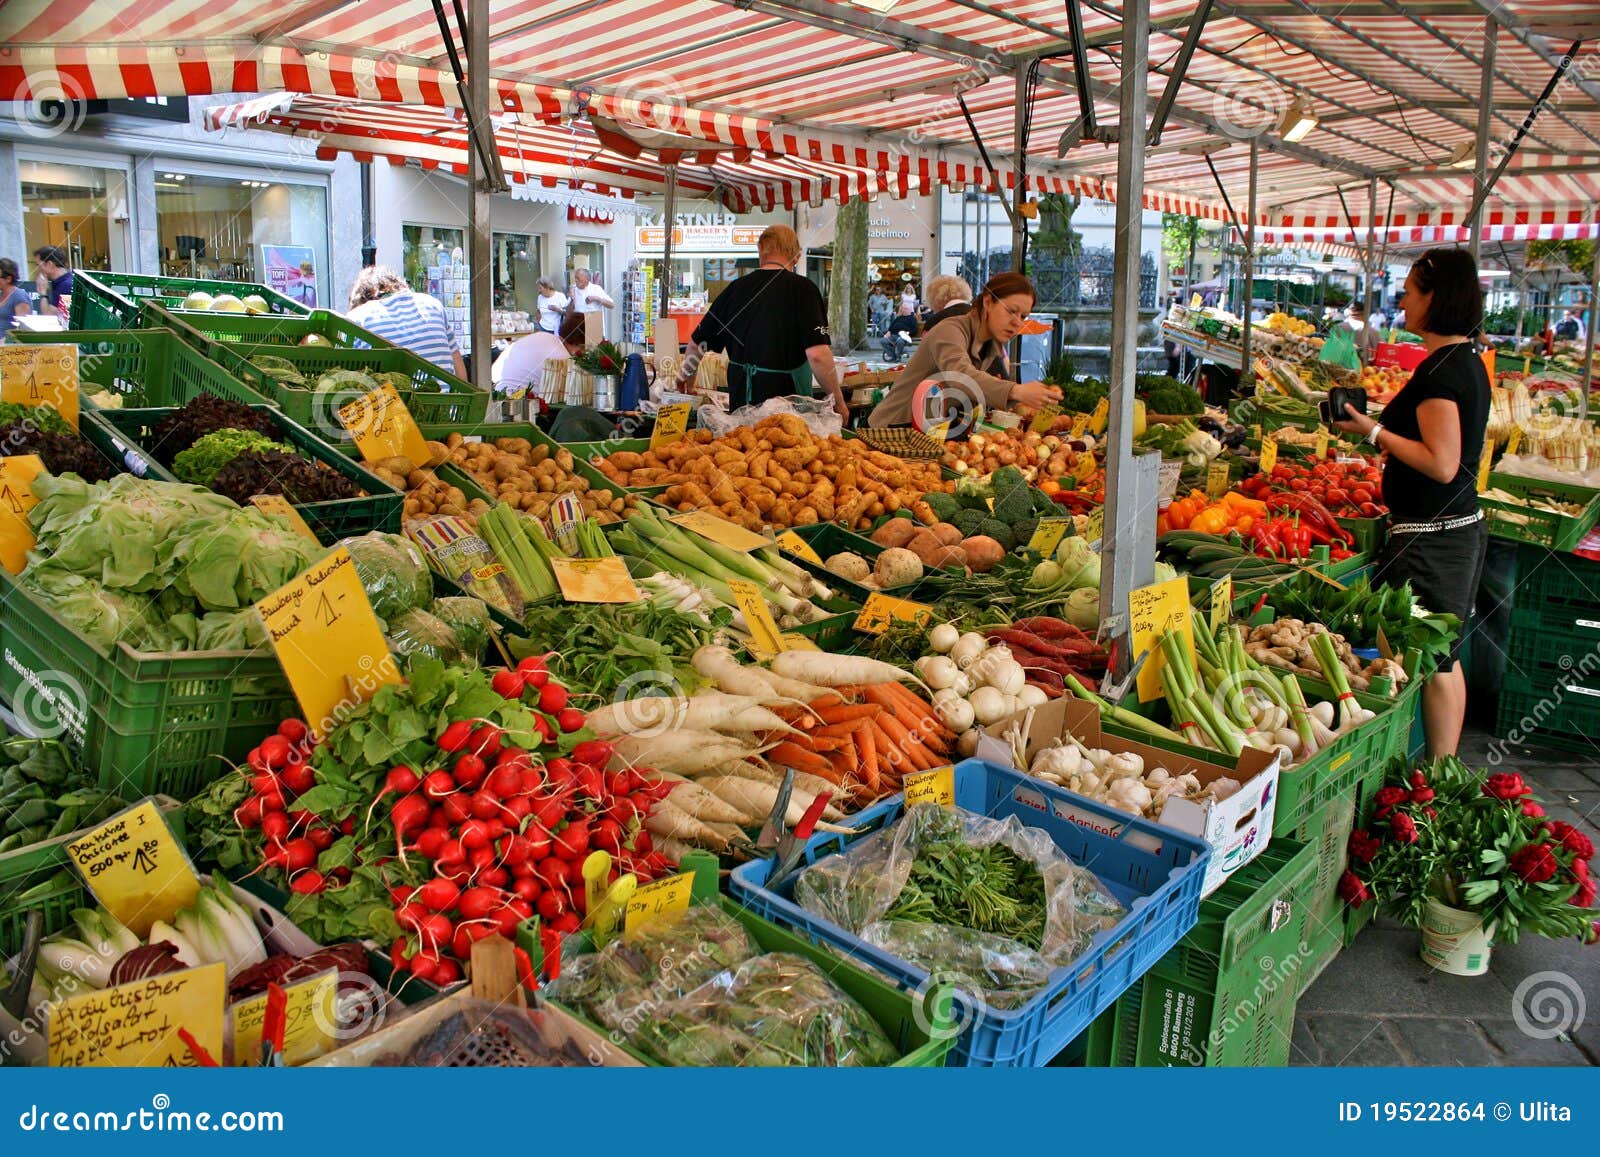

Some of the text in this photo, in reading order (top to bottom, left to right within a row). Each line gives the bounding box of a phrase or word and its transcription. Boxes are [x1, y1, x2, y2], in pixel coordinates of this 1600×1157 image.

[869, 216, 891, 227] uchs
[868, 228, 910, 239] abelmoo
[1172, 991, 1186, 1034] Bamberg
